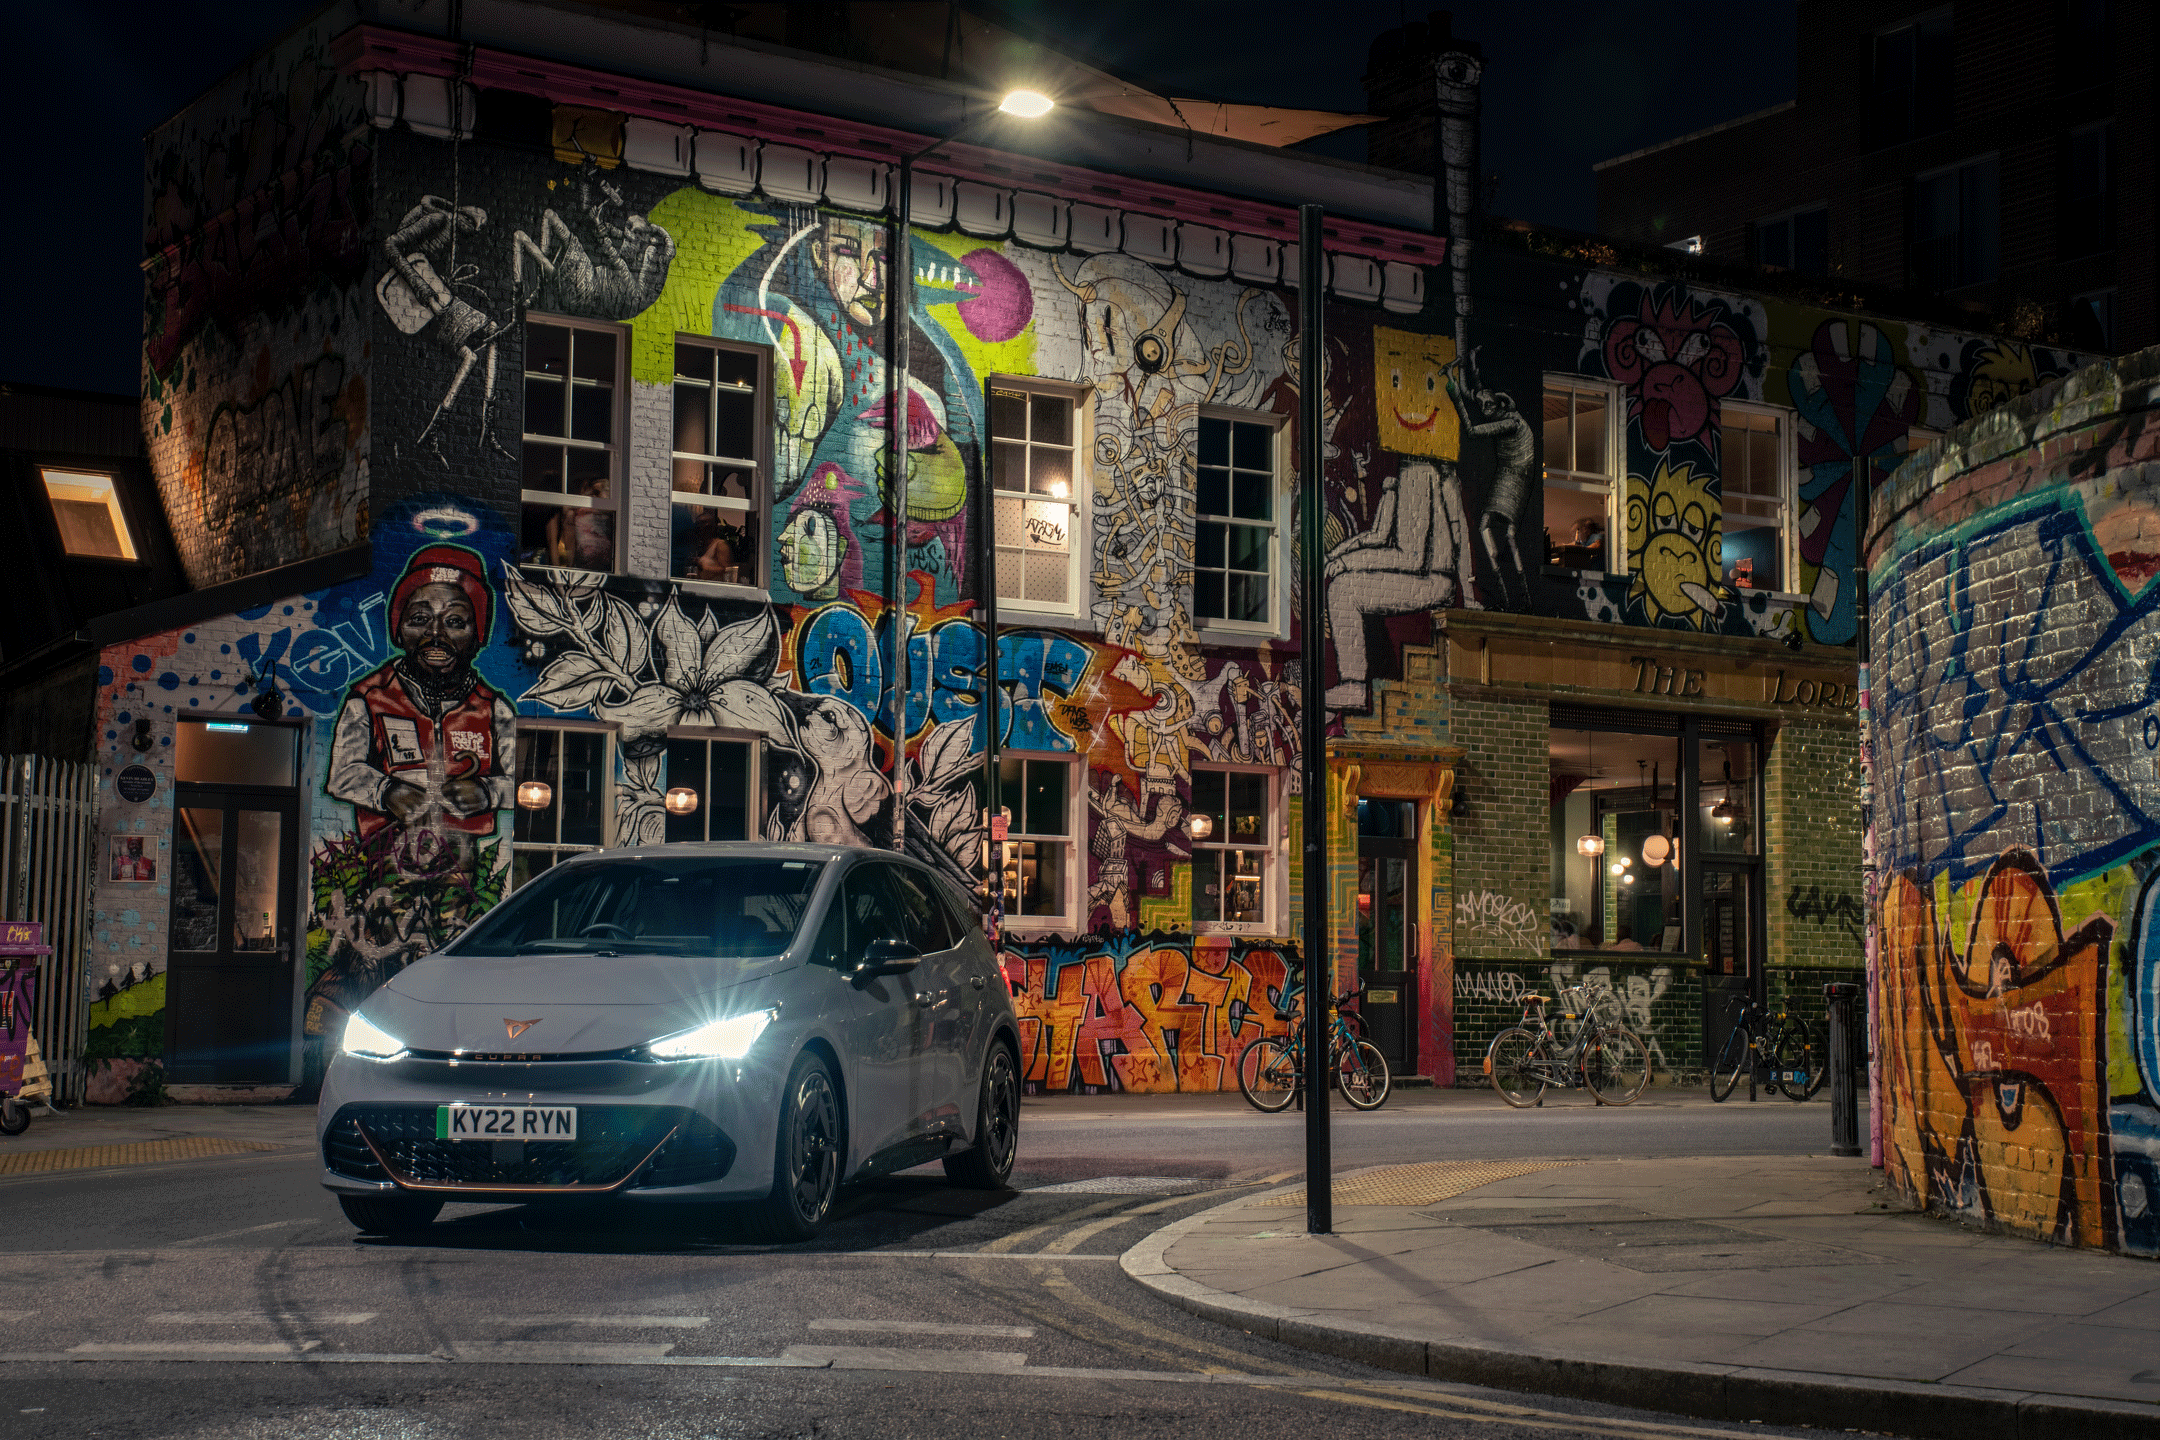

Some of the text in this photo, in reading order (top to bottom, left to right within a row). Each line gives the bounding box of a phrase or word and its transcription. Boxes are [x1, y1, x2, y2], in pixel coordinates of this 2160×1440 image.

[1630, 655, 1704, 697] THE
[453, 1109, 571, 1133] KY22 RYN
